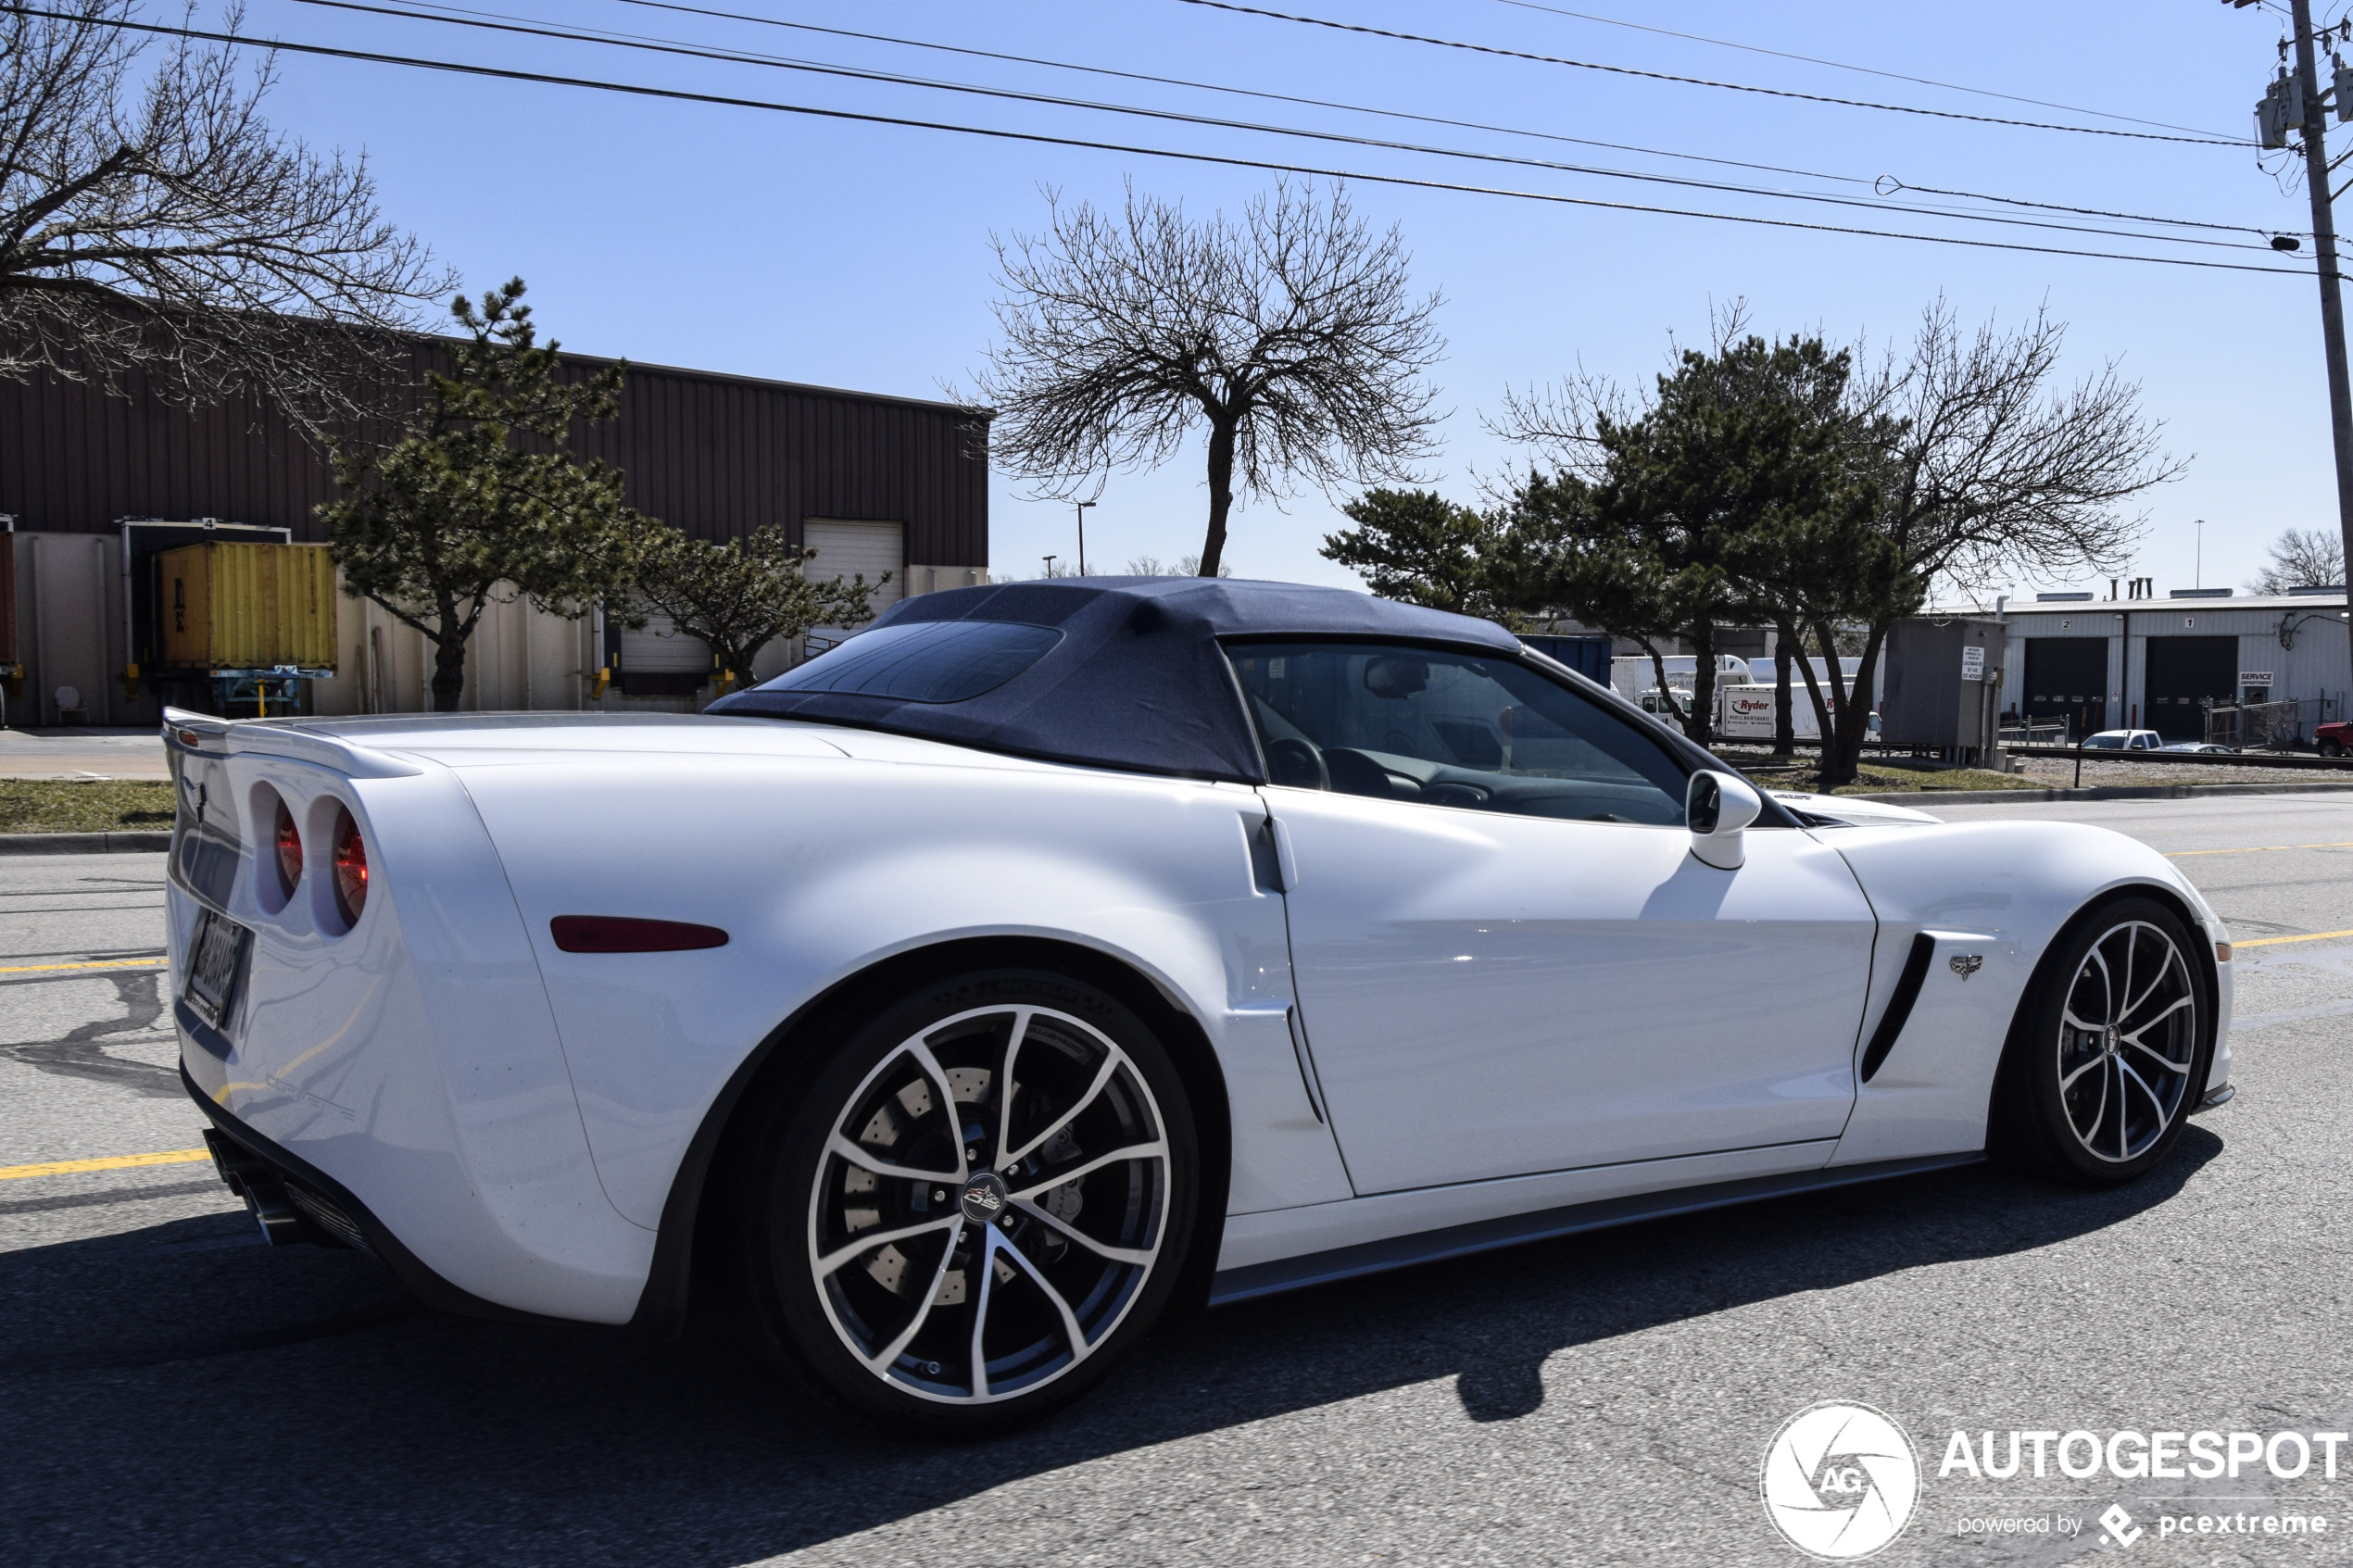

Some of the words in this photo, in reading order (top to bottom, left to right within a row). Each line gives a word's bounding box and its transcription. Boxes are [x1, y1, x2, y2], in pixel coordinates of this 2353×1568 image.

[205, 519, 214, 529] 4
[2063, 621, 2070, 629] 2
[2187, 619, 2193, 628] 1
[2241, 672, 2272, 681] SERVICE
[1741, 699, 1769, 712] Ryder
